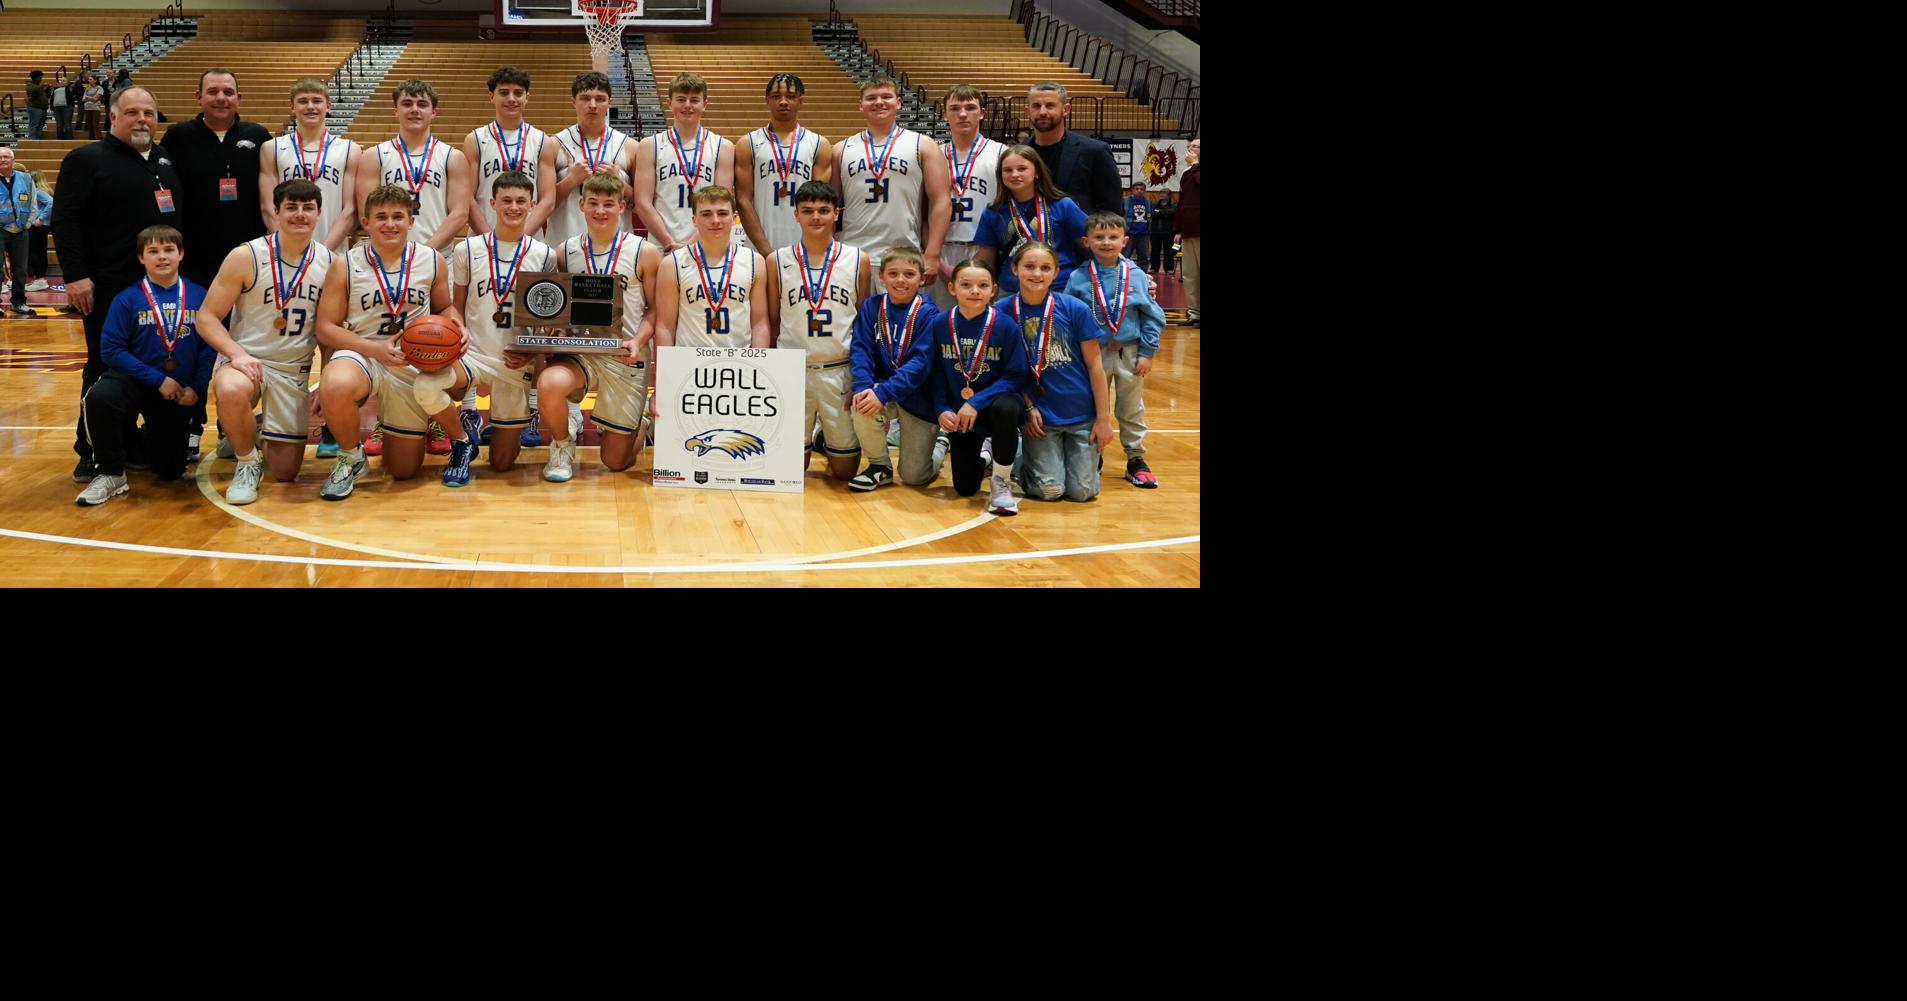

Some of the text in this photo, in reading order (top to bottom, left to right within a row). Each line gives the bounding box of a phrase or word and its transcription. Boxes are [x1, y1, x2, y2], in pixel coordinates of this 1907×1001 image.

[283, 163, 340, 185] EAES
[384, 166, 442, 189] EAES
[483, 157, 535, 179] EAES
[659, 161, 713, 182] EAES
[759, 159, 811, 180] EAES
[847, 156, 908, 177] EAES
[772, 181, 796, 207] 14
[864, 178, 890, 204] 31
[360, 286, 426, 312] EAES
[685, 282, 747, 305] EAES
[788, 283, 850, 307] EAES
[279, 308, 307, 337] 13
[496, 301, 513, 329] 5
[704, 307, 731, 335] 10
[805, 309, 833, 338] 12
[519, 337, 617, 347] STATE CONSOLATION
[695, 347, 768, 359] State "B" 2025
[694, 367, 767, 390] WALL
[681, 393, 778, 417] EAGLES
[653, 468, 681, 477] Billion
